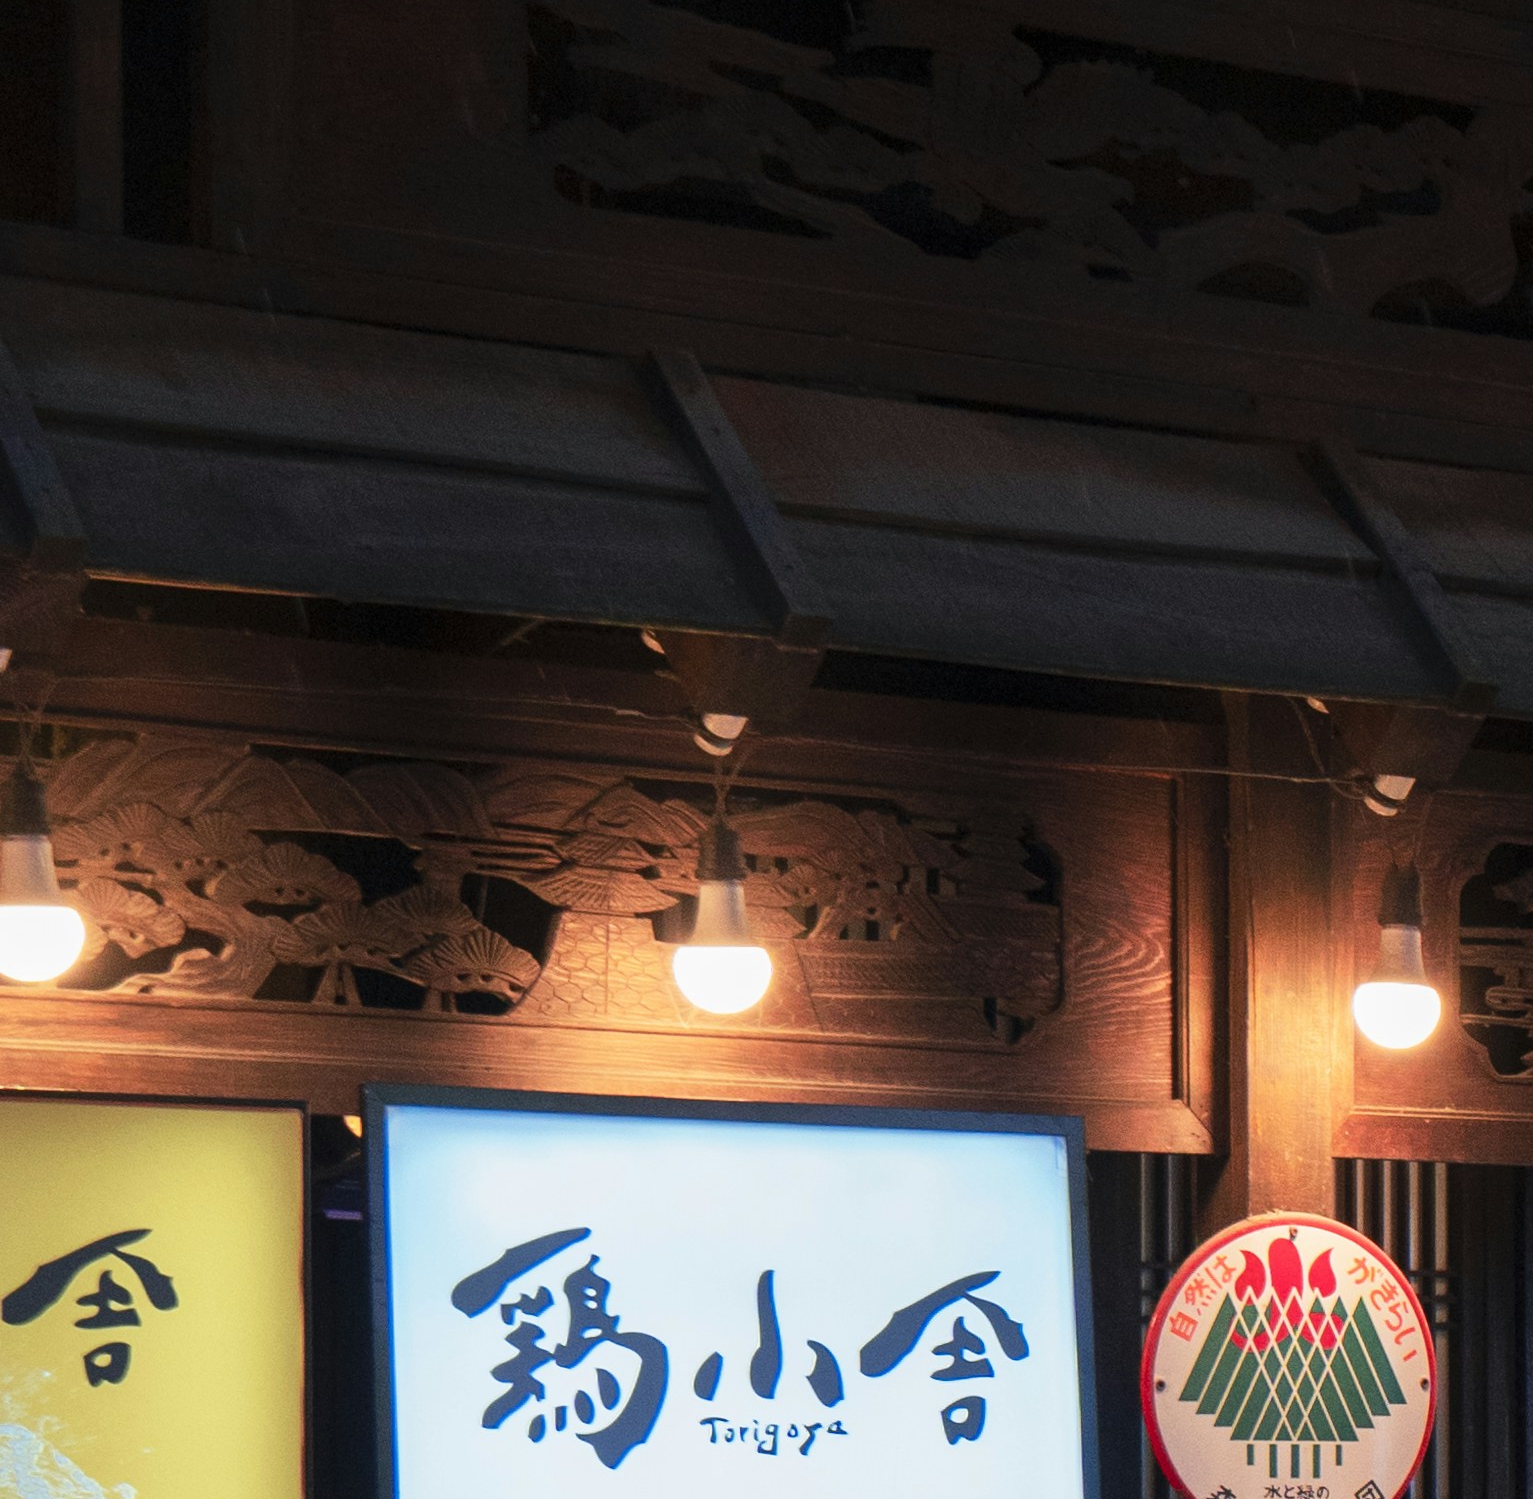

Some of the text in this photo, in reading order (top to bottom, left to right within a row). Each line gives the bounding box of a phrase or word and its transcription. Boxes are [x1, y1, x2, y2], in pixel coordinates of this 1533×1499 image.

[1168, 1253, 1238, 1344] 自然は
[698, 1416, 850, 1457] Torigoya
